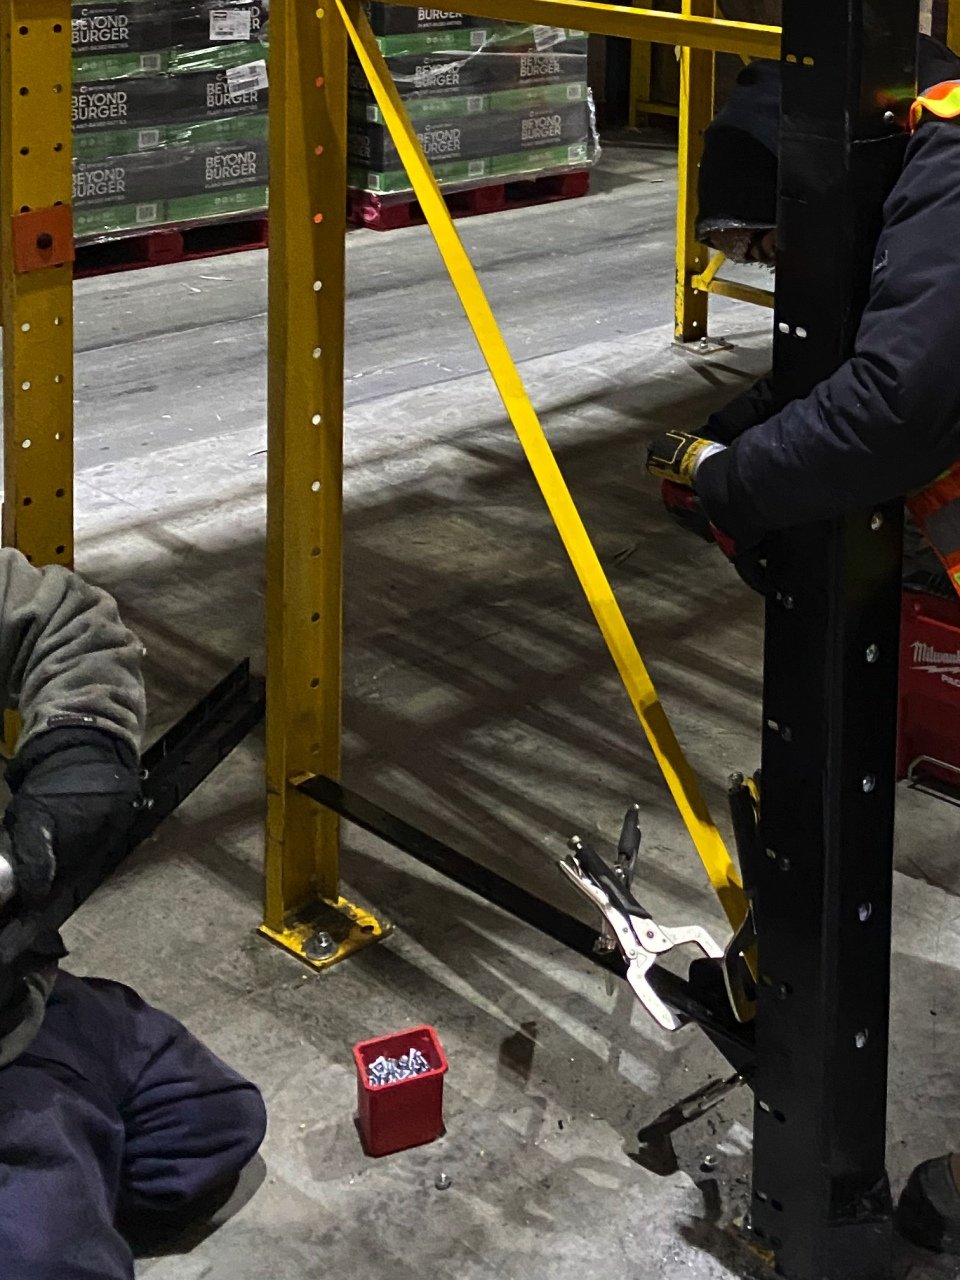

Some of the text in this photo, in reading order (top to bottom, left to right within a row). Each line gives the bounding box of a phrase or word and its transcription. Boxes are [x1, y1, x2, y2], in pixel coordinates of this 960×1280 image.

[72, 28, 129, 43] BURGER
[520, 63, 560, 77] BURGER
[207, 83, 229, 95] BEY
[522, 115, 561, 130] BEYOND
[522, 126, 561, 140] BURGER
[206, 151, 257, 169] BEYOND
[206, 163, 257, 181] BURGER
